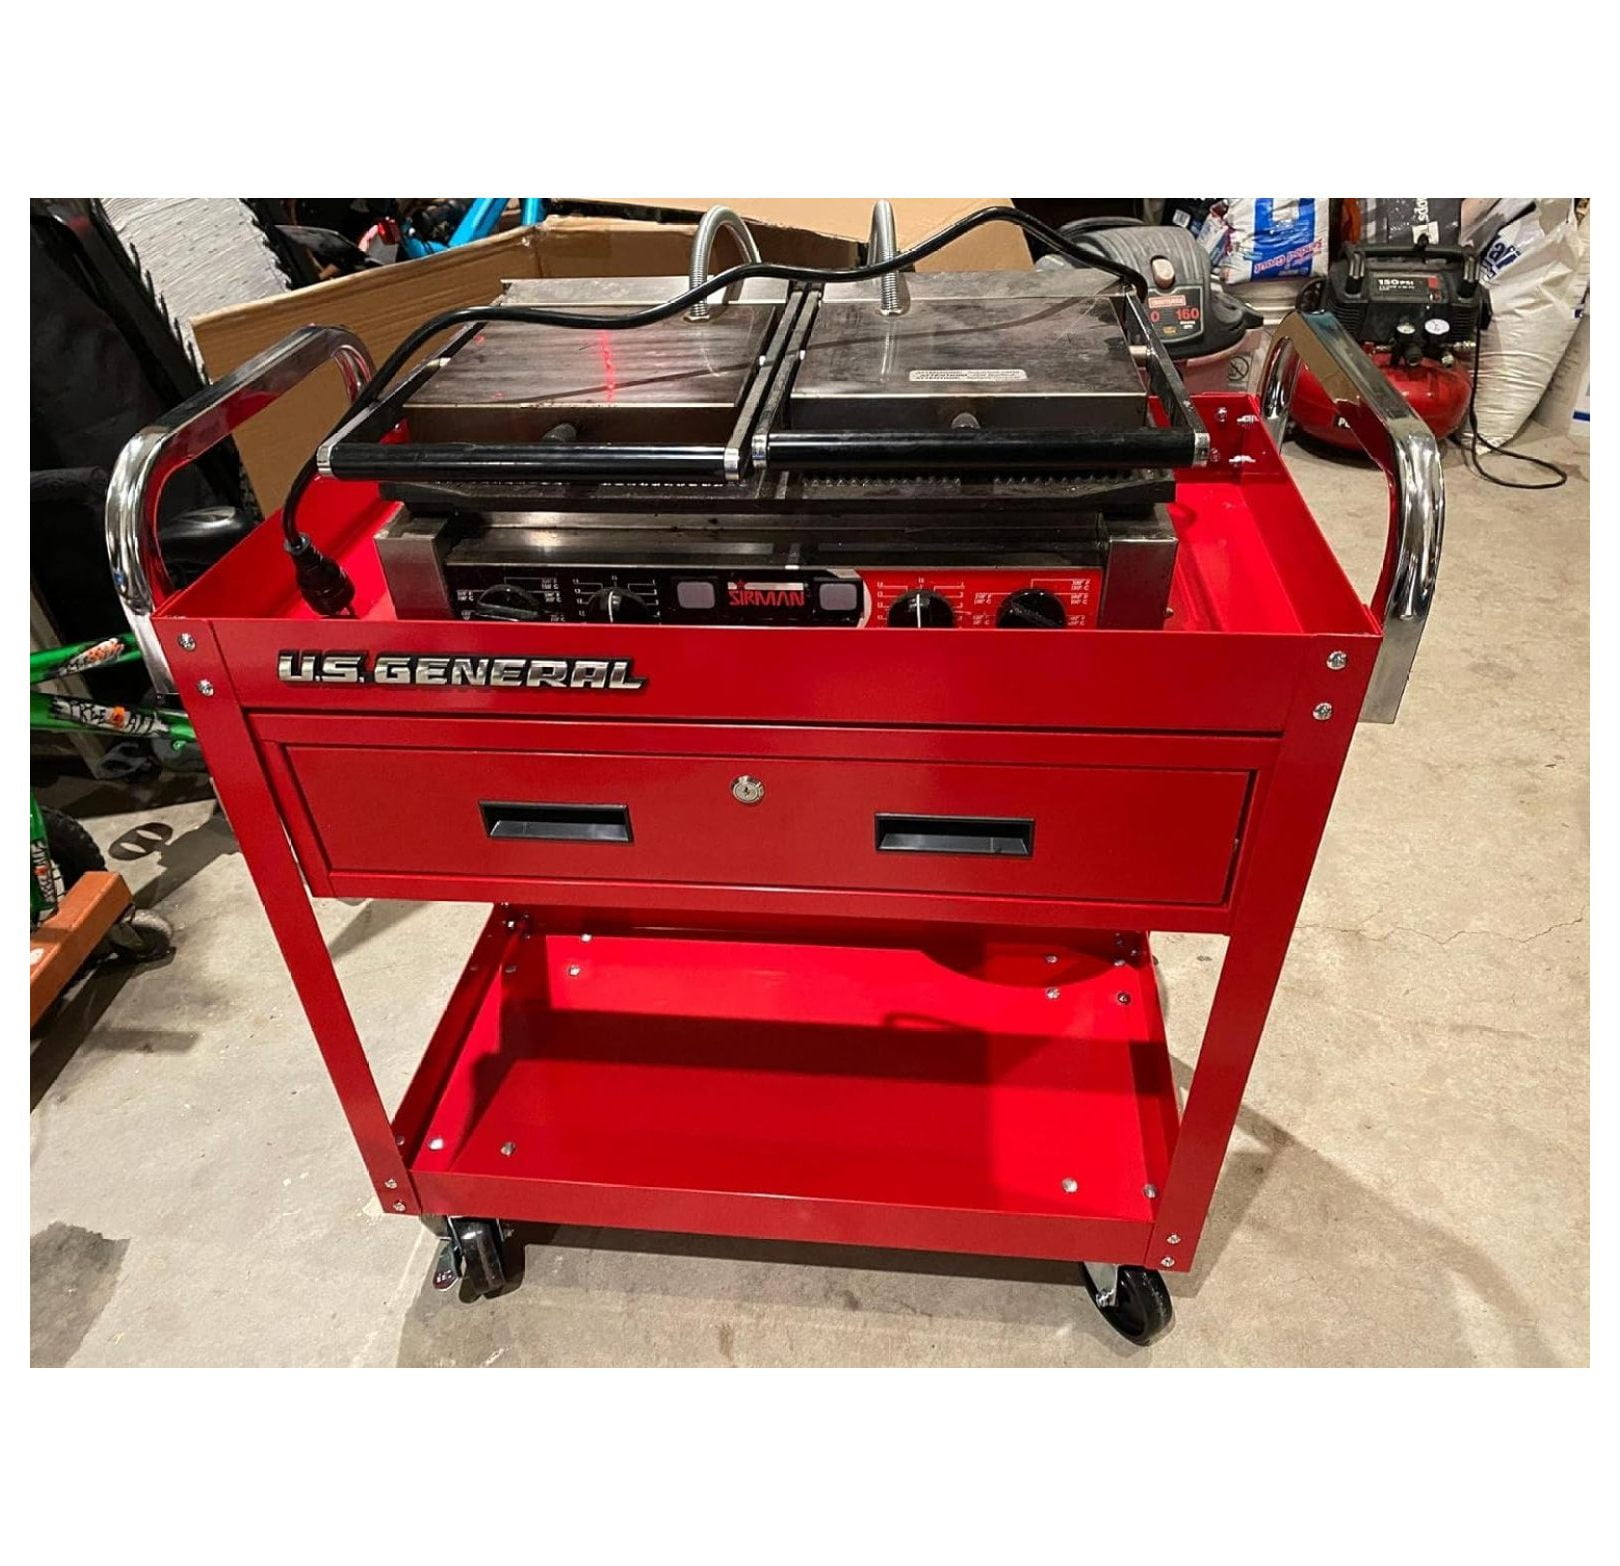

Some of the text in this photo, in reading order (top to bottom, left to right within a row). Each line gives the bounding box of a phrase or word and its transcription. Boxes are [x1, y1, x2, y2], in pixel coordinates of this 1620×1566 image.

[1176, 308, 1200, 321] 160
[728, 590, 805, 606] SIRMAN
[373, 656, 646, 690] GENERAL
